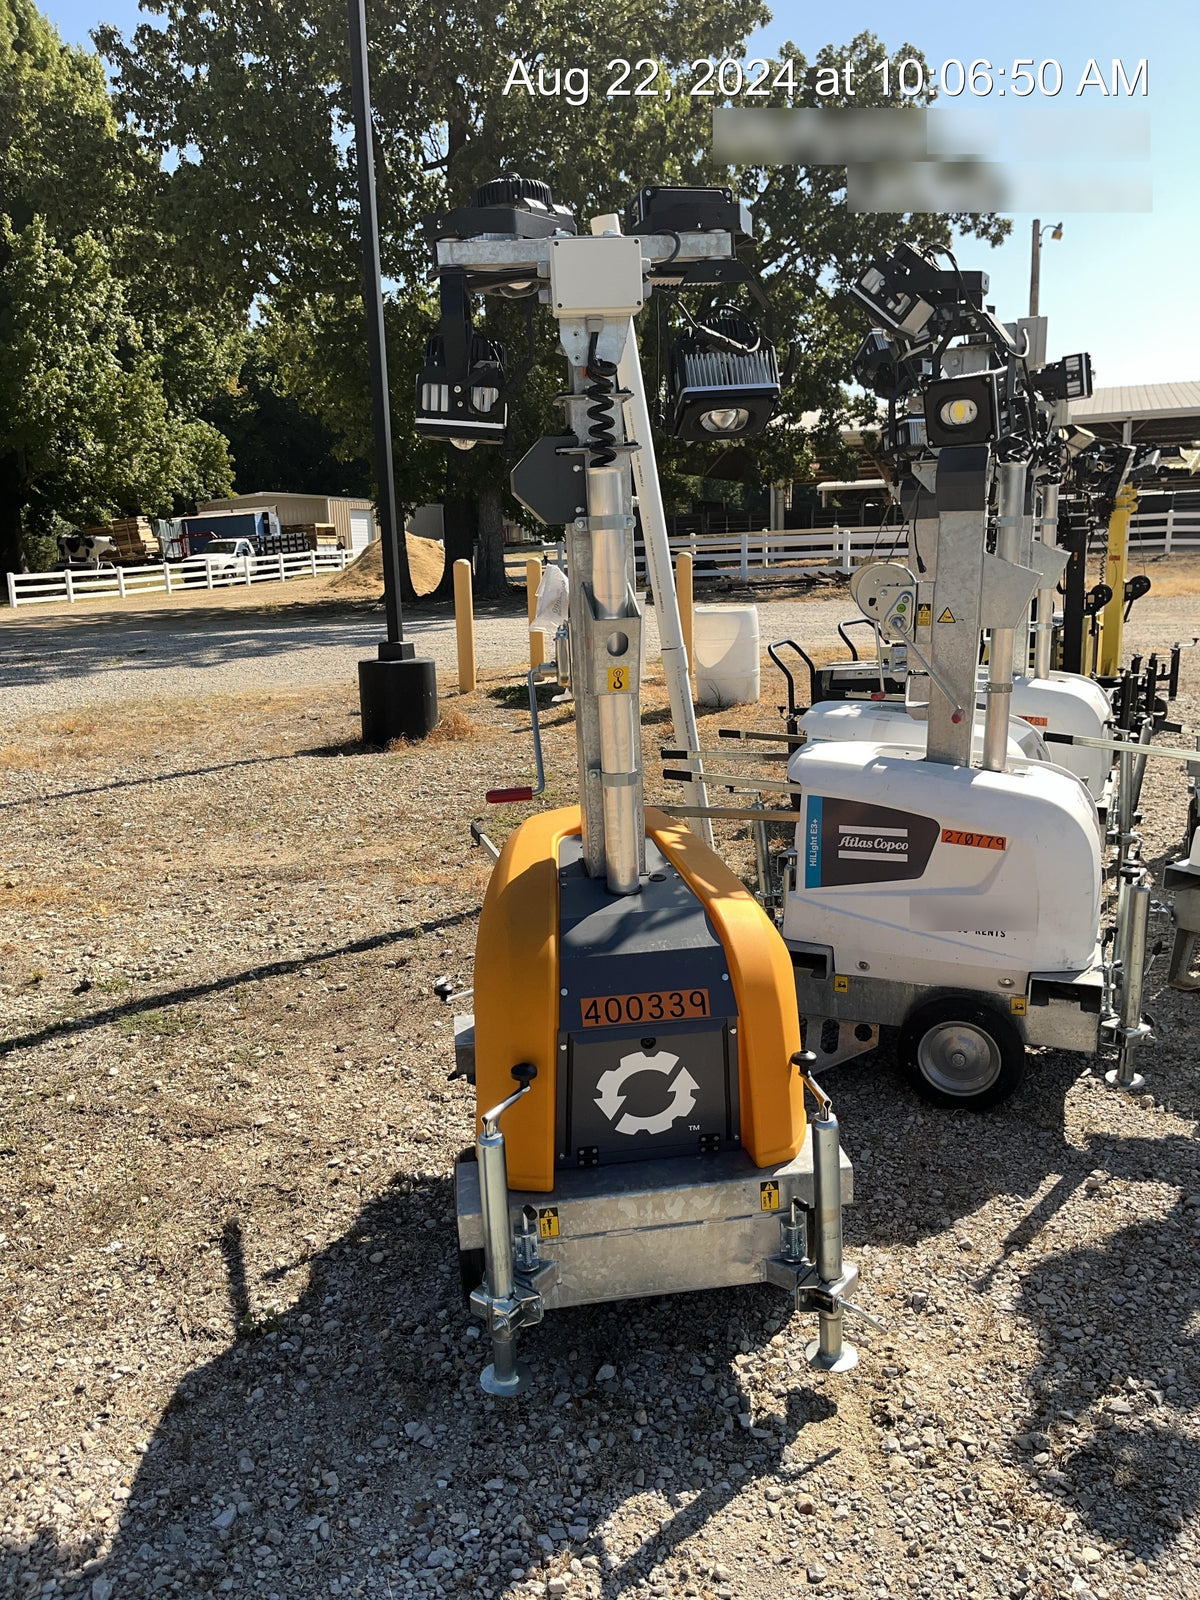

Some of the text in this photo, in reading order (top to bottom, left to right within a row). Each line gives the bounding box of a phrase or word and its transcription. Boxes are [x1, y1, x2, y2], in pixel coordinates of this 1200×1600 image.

[809, 836, 819, 867] HiLight
[838, 835, 909, 852] Atlas Copco
[944, 829, 1005, 850] 270779
[583, 990, 708, 1025] 400339
